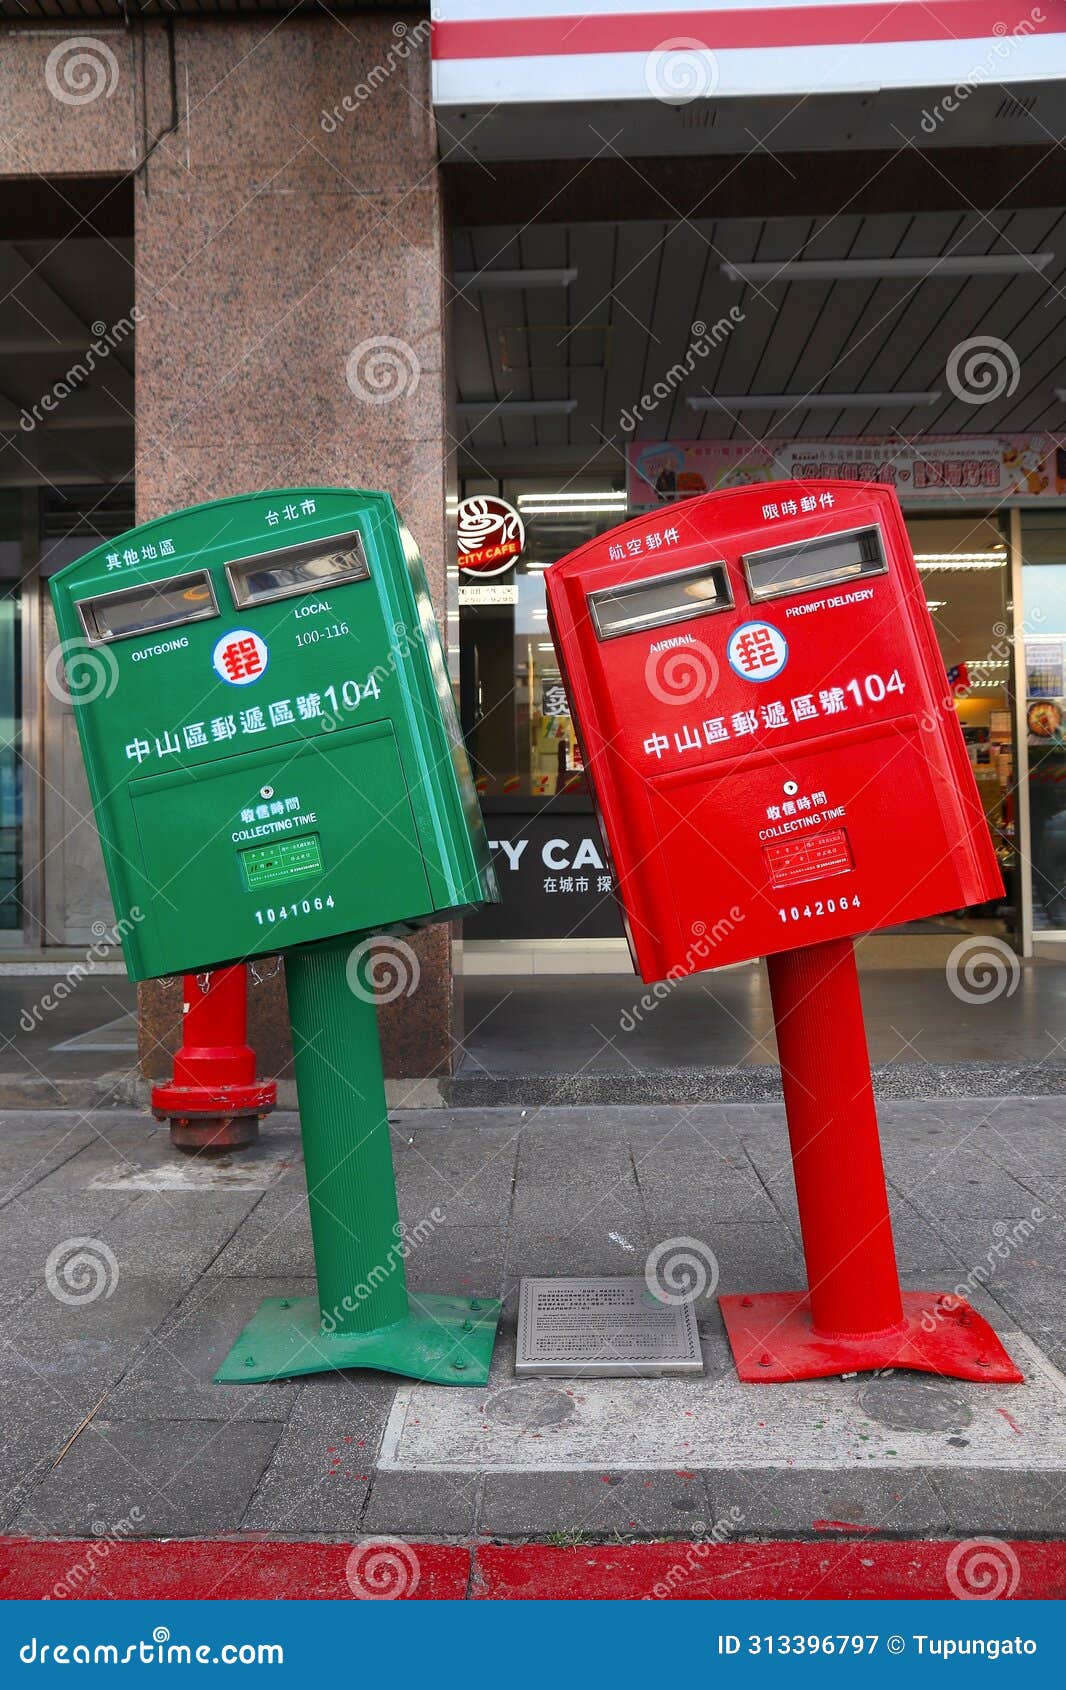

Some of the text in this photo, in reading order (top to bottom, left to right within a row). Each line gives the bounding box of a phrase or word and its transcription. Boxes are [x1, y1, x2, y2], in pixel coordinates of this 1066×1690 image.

[265, 499, 317, 526] 台北市
[761, 491, 835, 520] 限時郵件
[105, 538, 176, 570] 其他地區
[457, 543, 517, 566] CITY CAFE
[608, 527, 680, 561] 航空郵件
[294, 601, 332, 619] LOCAL
[785, 588, 875, 617] PROMPT DELIVERY
[295, 622, 349, 648] 100-116
[650, 634, 696, 654] AIRMAIL
[131, 637, 189, 663] OUTGOING
[240, 796, 301, 824] 收信時間
[766, 790, 828, 821] 收信時間
[231, 812, 317, 843] COLLECTING TIME
[758, 805, 846, 841] COLLECTING TIME
[541, 838, 609, 870] CA
[543, 875, 612, 893] 在城市 探
[255, 895, 335, 925] 1041064
[778, 894, 861, 923] 1042064
